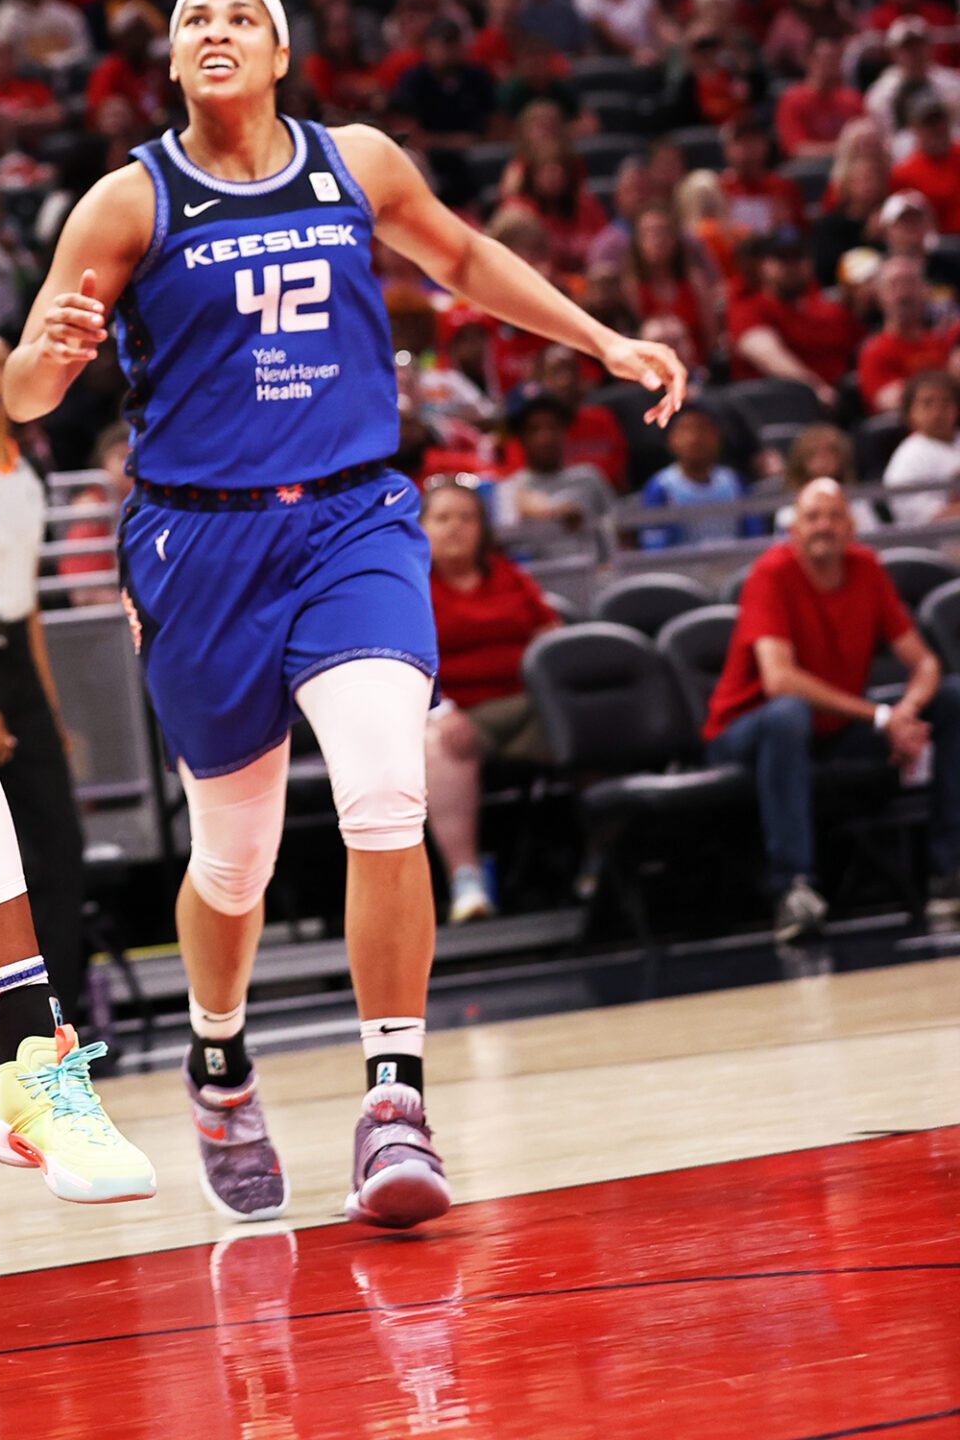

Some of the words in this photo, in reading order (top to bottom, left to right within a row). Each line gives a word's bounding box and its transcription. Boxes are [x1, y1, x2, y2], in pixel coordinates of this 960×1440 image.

[184, 224, 357, 269] KEESUSK
[235, 259, 331, 335] 42
[252, 347, 287, 366] Yale
[256, 382, 312, 402] Health
